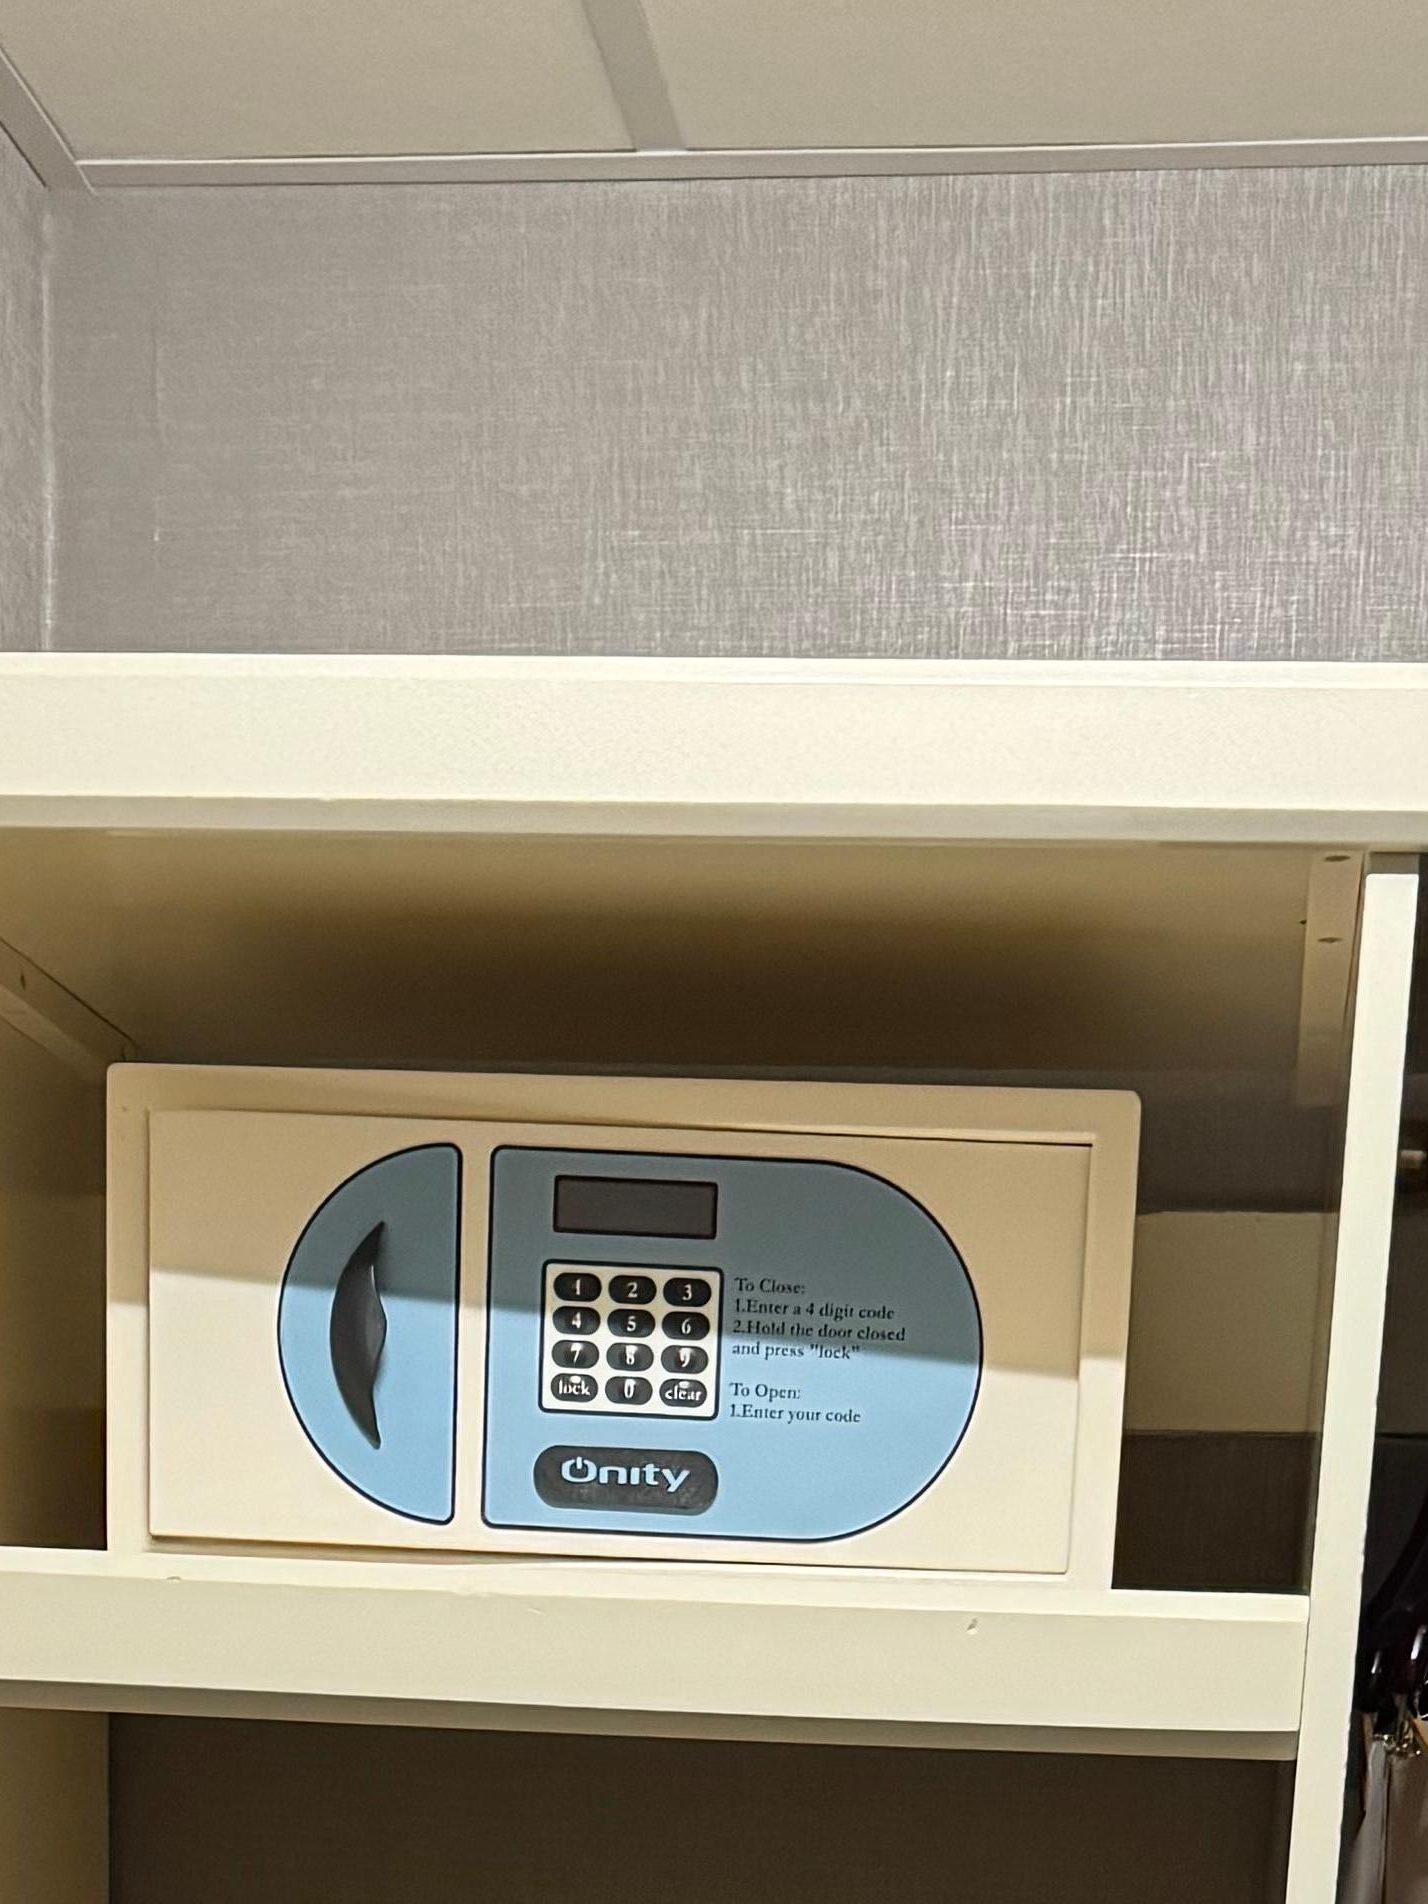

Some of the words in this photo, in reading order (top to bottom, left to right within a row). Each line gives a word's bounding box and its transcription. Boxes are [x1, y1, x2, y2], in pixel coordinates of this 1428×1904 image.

[575, 1278, 581, 1296] 1
[627, 1282, 638, 1298] 2
[682, 1284, 693, 1301] 3
[734, 1277, 754, 1292] To
[760, 1278, 806, 1294] Close:
[793, 1305, 801, 1315] a
[806, 1303, 814, 1315] 4
[819, 1303, 854, 1322] digit
[859, 1306, 894, 1320] code
[572, 1312, 582, 1329] 4
[626, 1316, 637, 1332] 5
[681, 1319, 691, 1335] 6
[790, 1323, 813, 1337] the
[818, 1325, 852, 1338] door
[857, 1326, 905, 1341] closed
[571, 1342, 583, 1363] 7
[625, 1345, 637, 1365] 8
[679, 1348, 690, 1368] 9
[732, 1341, 760, 1355] and
[765, 1345, 804, 1360] press
[558, 1379, 591, 1396] lock
[624, 1379, 635, 1398] 0
[664, 1385, 702, 1402] clear
[730, 1383, 750, 1397] To
[755, 1384, 801, 1402] Open:
[787, 1411, 821, 1424] your
[826, 1409, 861, 1423] code
[561, 1456, 690, 1493] Onity
